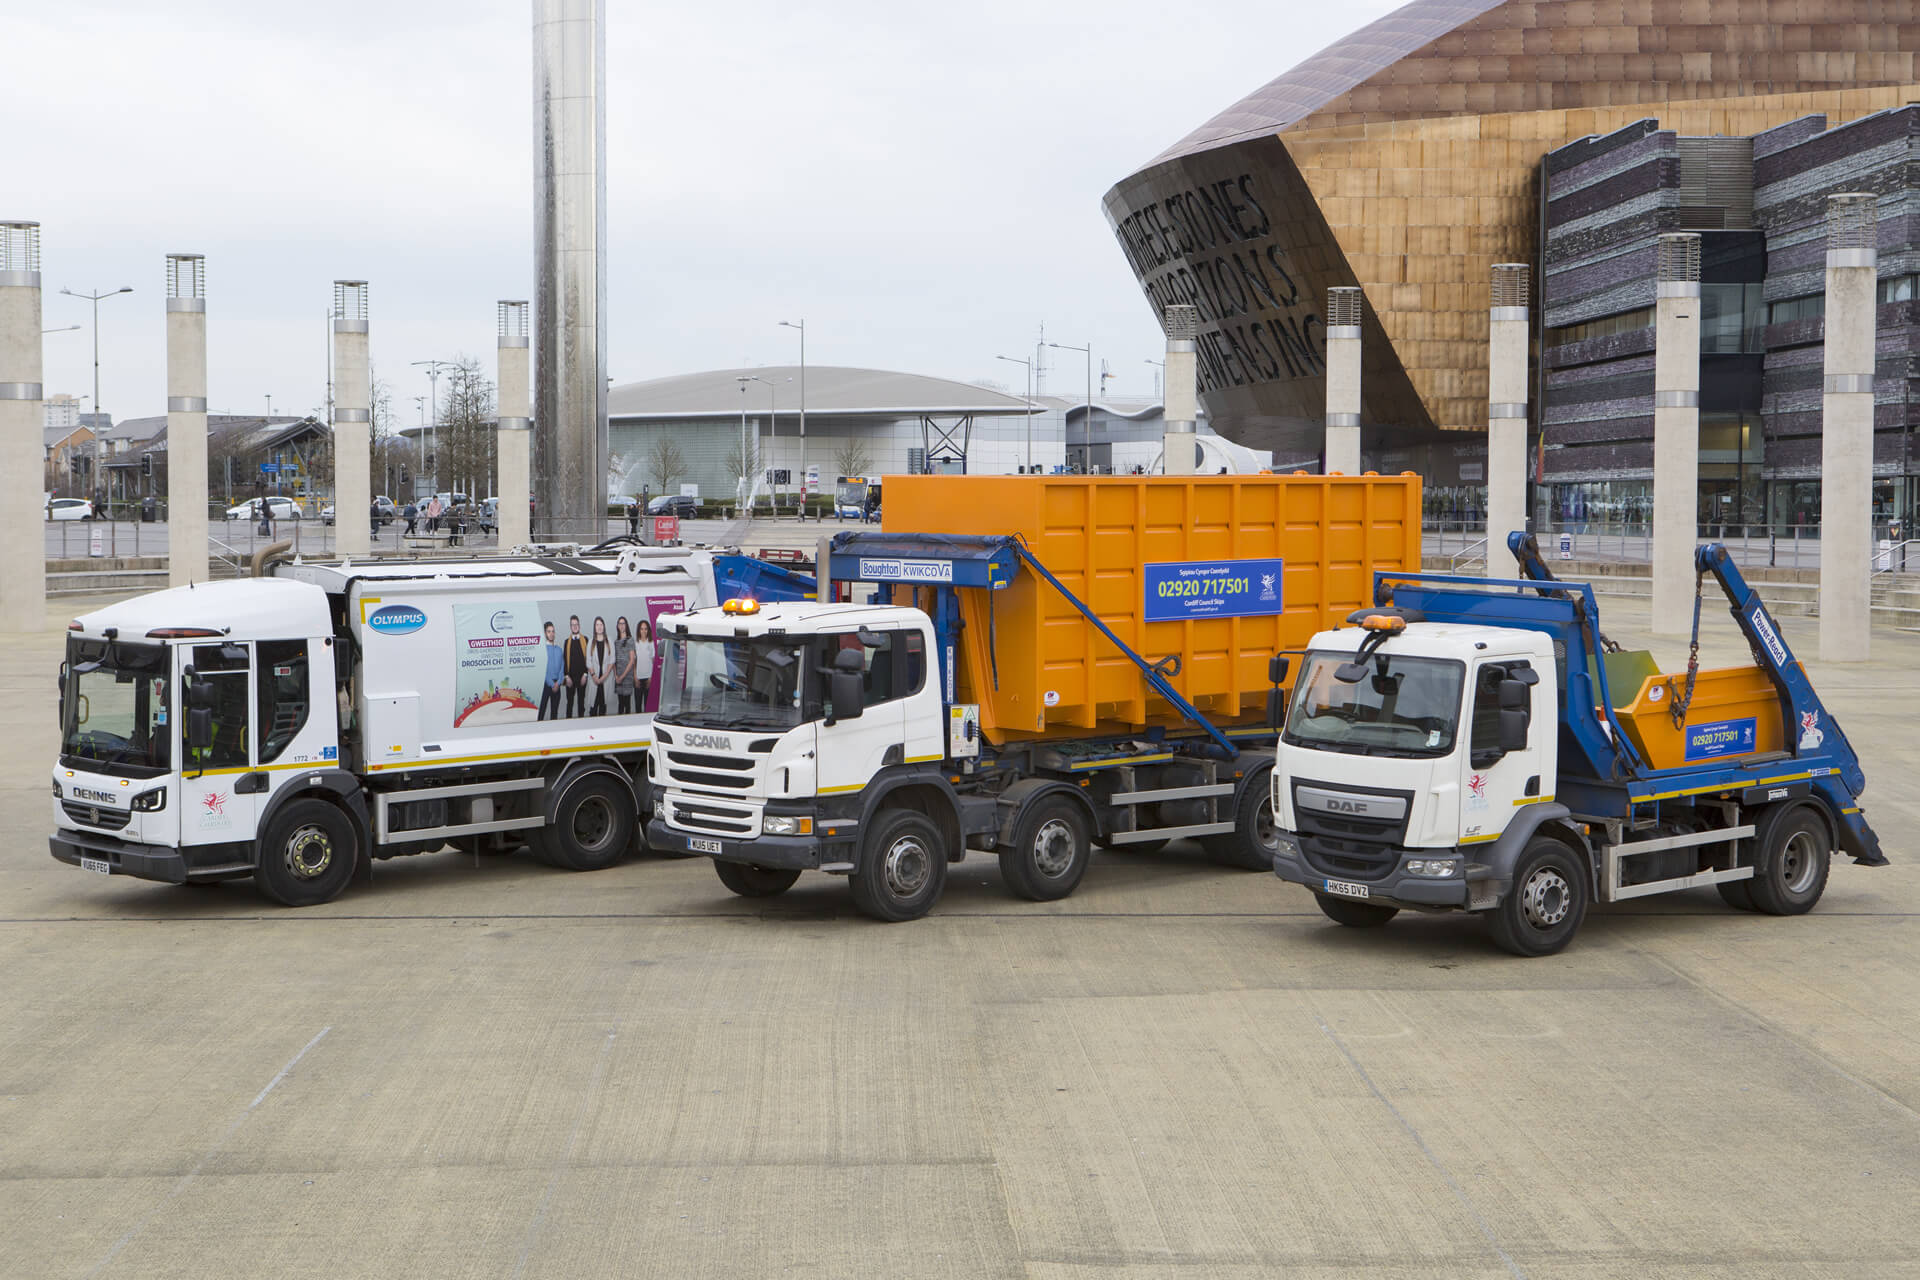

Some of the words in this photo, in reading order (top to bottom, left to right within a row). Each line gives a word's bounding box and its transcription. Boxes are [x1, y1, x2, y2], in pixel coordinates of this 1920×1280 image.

[1165, 174, 1271, 255] STONES
[863, 562, 899, 576] Boughton
[903, 562, 951, 577] KWIKCOVA
[1158, 580, 1200, 597] 02920
[1202, 577, 1249, 595] 717501
[373, 614, 423, 625] OLYMPUS
[470, 639, 503, 648] GWEITHIO
[508, 637, 538, 646] WORKING
[461, 659, 491, 667] DROSOCH
[509, 657, 521, 665] FOR
[684, 733, 732, 751] SCANIA
[1692, 733, 1713, 746] 02920
[1713, 729, 1739, 743] 717501
[73, 787, 117, 804] DENNIS
[1327, 799, 1368, 813] DAF
[1328, 880, 1350, 894] HK65
[1351, 884, 1367, 897] DVZ
